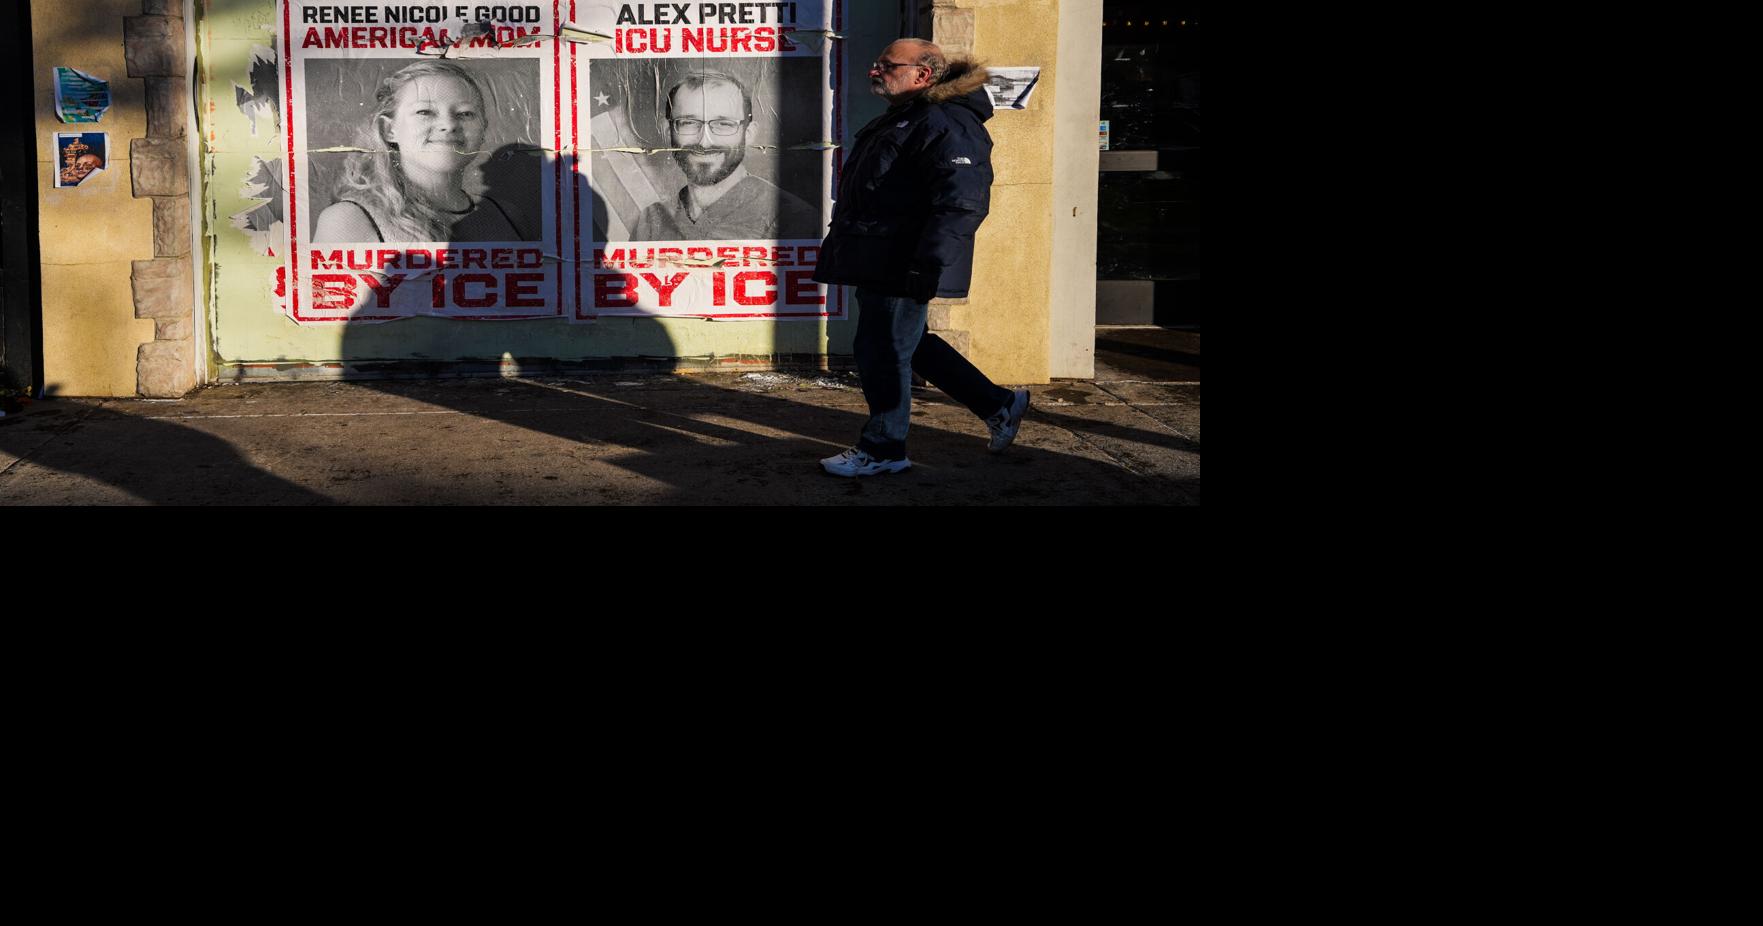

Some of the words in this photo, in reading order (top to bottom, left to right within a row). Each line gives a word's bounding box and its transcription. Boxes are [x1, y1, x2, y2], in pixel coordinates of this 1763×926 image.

[303, 6, 378, 23] RENEE
[475, 6, 540, 23] GOOD
[616, 3, 691, 25] ALEX
[702, 2, 796, 24] PRETTI
[615, 28, 671, 53] ICU
[682, 27, 796, 53] NURSE
[311, 249, 543, 270] MURDERED
[594, 246, 821, 269] MURDERED
[312, 273, 407, 309] BY
[432, 273, 544, 308] ICE
[594, 271, 689, 308] BY
[713, 271, 825, 306] ICE
